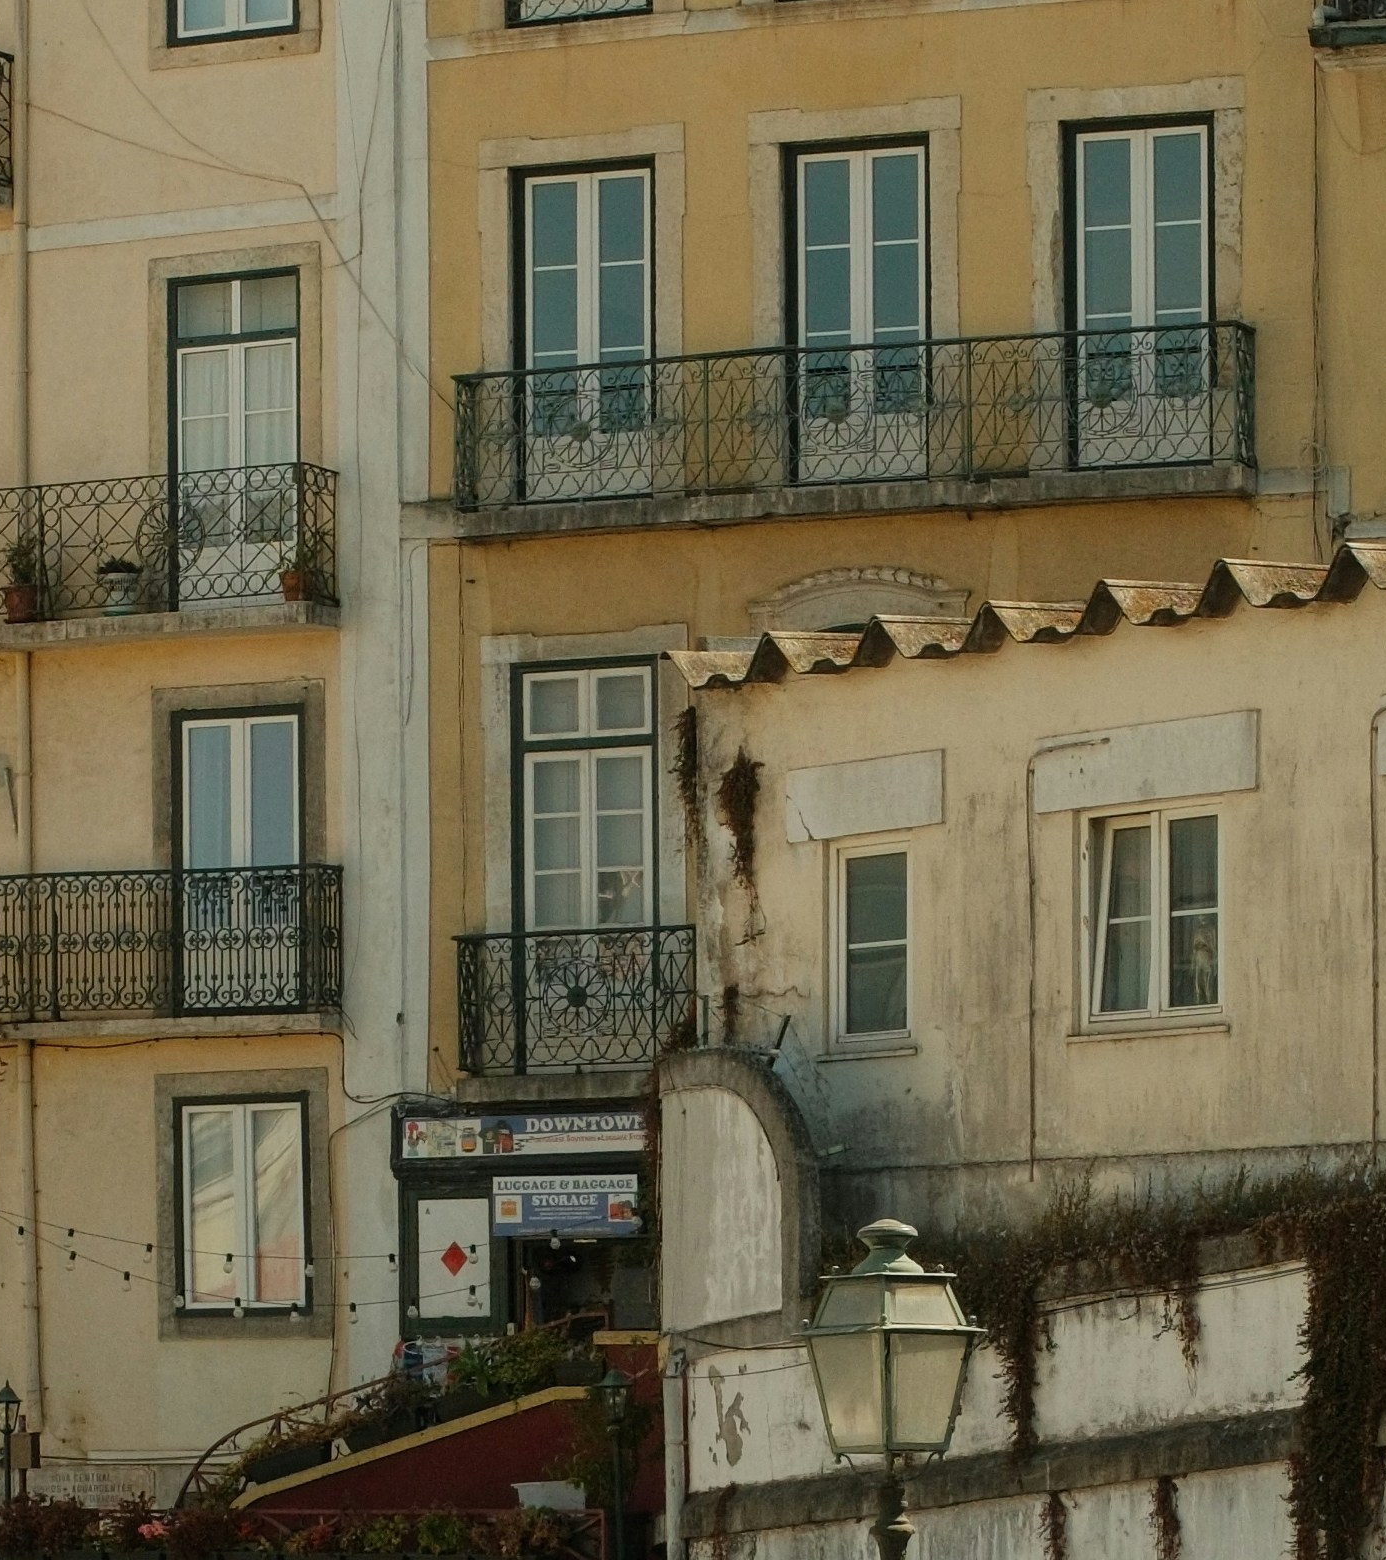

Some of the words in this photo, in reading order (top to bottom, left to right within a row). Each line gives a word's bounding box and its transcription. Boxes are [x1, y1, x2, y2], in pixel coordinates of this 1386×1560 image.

[497, 1180, 556, 1191] LUGGAGE
[559, 1179, 569, 1190] &
[573, 1178, 633, 1189] BAGGAGE
[531, 1193, 599, 1207] STORAGE
